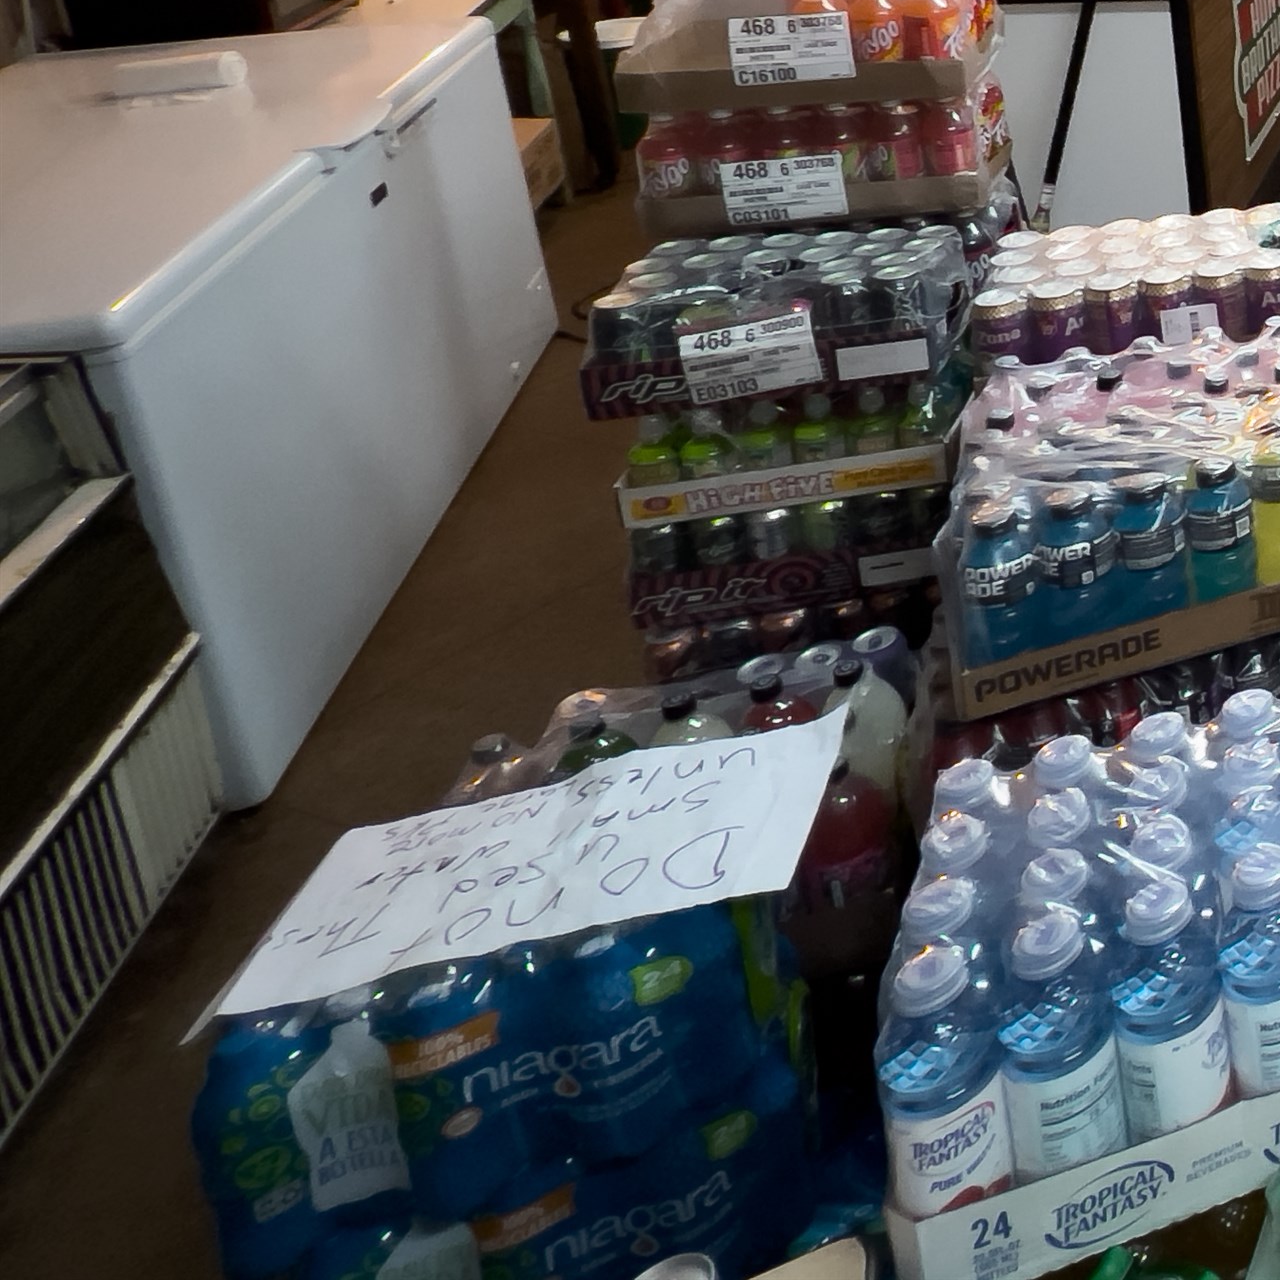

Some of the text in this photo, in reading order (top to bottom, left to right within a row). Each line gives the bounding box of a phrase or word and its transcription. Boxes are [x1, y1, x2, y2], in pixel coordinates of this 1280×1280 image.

[741, 18, 776, 36] 468
[787, 19, 797, 33] 6
[738, 67, 798, 85] C16100
[733, 161, 768, 179] 468
[780, 163, 790, 176] 6
[731, 207, 790, 225] C03101
[693, 329, 732, 351] 468
[744, 328, 755, 342] 6
[695, 378, 759, 403] E03103
[975, 628, 1161, 703] POWERADE
[463, 1015, 664, 1103] niagara
[911, 1107, 990, 1161] TROPICAL
[915, 1122, 991, 1173] FANTASY
[1051, 1163, 1165, 1231] TROPICAL
[1064, 1180, 1164, 1246] FANTASY
[543, 1169, 733, 1274] niagara
[969, 1210, 1014, 1251] 24
